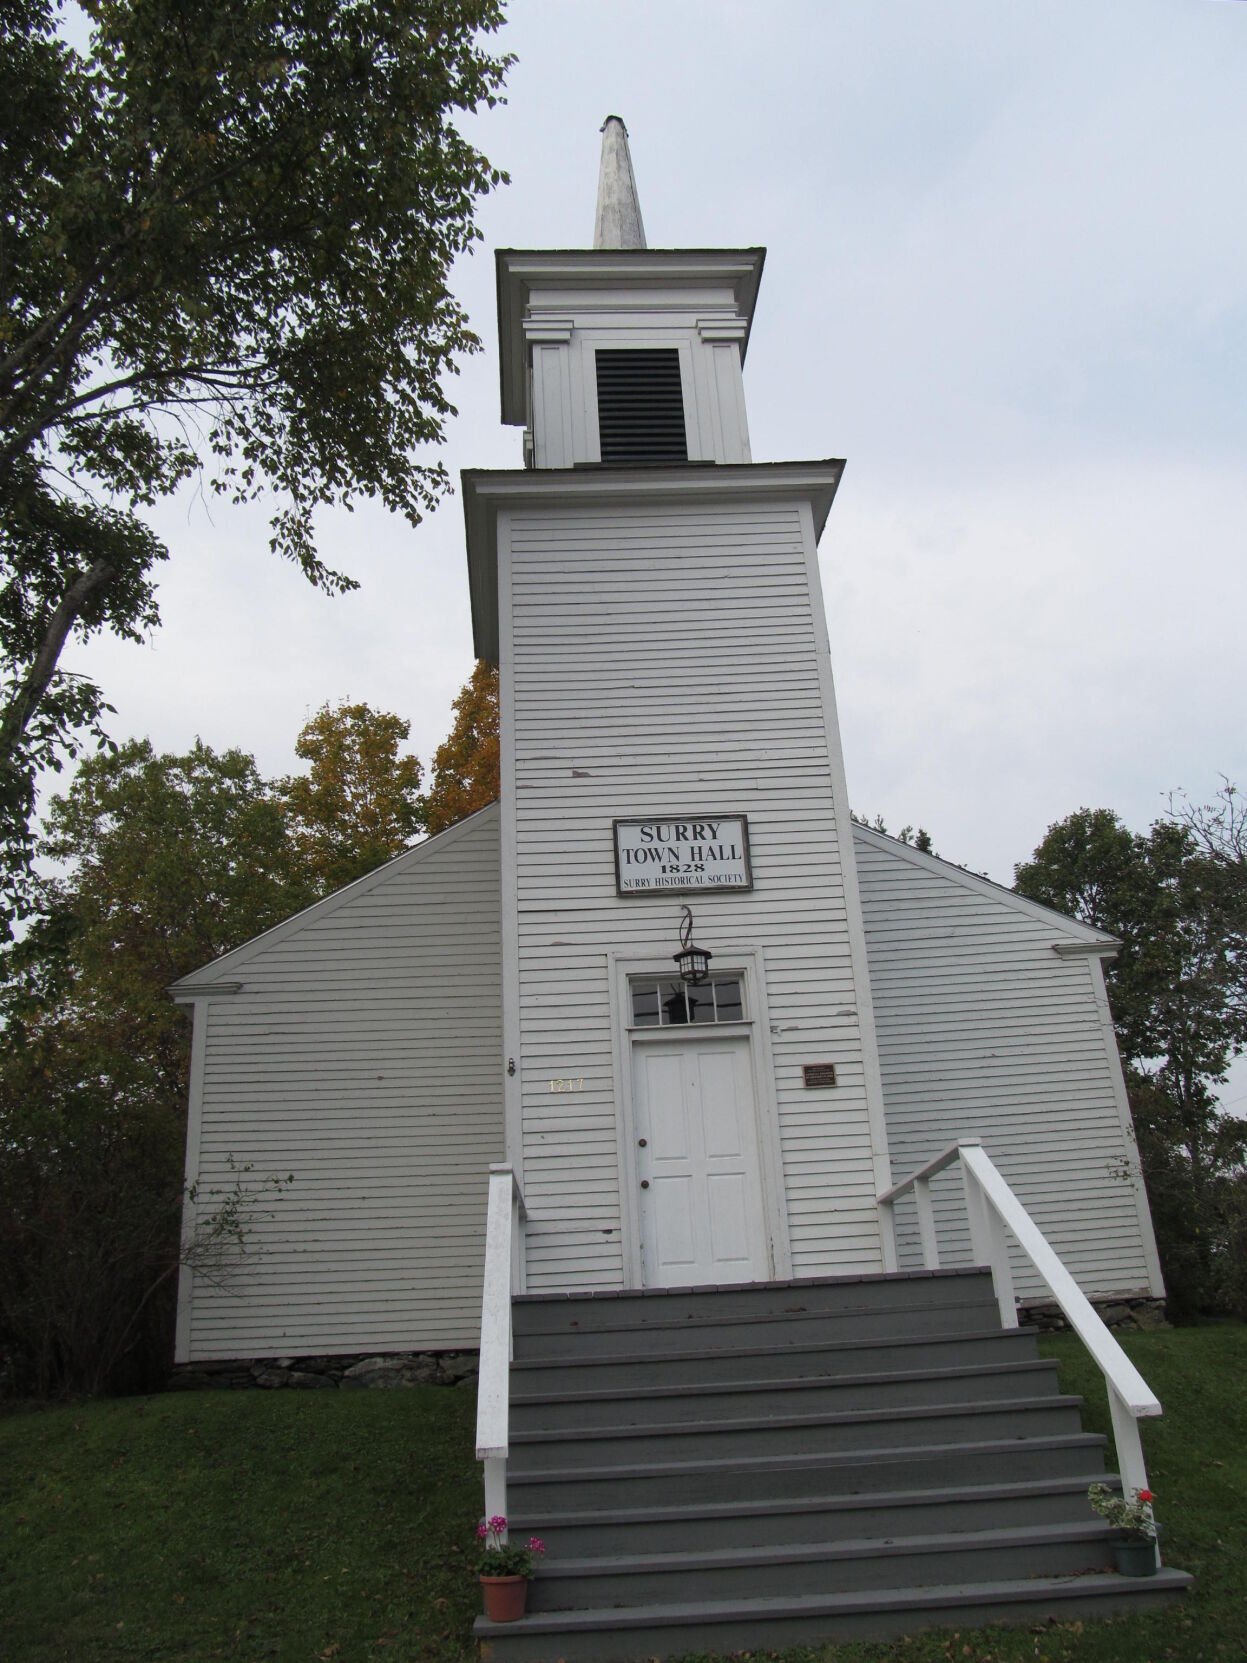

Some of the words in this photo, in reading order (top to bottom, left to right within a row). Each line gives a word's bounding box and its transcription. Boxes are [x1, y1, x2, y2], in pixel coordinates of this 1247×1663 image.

[640, 823, 721, 843] SURRY
[622, 847, 680, 864] TOWN
[690, 844, 742, 862] HALL
[660, 863, 705, 874] 1828
[623, 878, 651, 888] SURRY
[655, 874, 705, 886] HISTORICAL
[708, 873, 744, 884] SOCIETY
